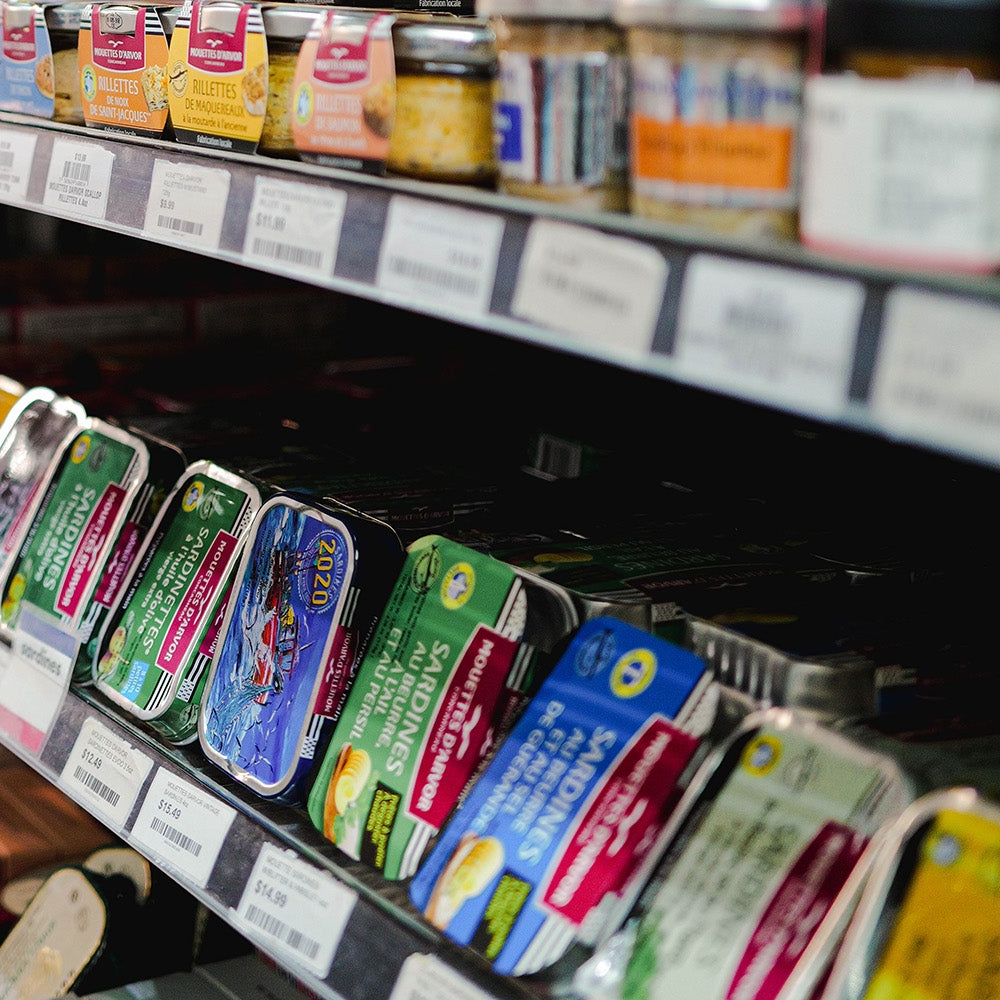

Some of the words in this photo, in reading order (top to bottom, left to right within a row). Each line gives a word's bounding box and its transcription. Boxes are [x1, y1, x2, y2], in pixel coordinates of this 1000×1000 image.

[446, 0, 462, 7] locale
[94, 47, 118, 58] MOUETTES
[119, 49, 142, 61] D'ARVOR
[99, 77, 139, 96] RILLETTES
[106, 95, 115, 105] DE
[115, 96, 129, 107] NOIX
[193, 79, 237, 99] RILLETTES
[90, 103, 98, 116] DE
[185, 98, 194, 110] DE
[195, 100, 246, 117] MAQUEREAUX
[43, 487, 98, 591] SARDINES
[83, 491, 118, 553] MOUETTES
[185, 533, 194, 543] à
[62, 553, 92, 608] D'ARVOR
[153, 550, 177, 582] vierge
[161, 544, 190, 589] l'huile
[194, 539, 227, 603] MOUETTES
[312, 539, 337, 606] 2020
[327, 546, 346, 600] SARDINES
[136, 588, 166, 635] d'olive
[140, 580, 157, 609] extra
[163, 601, 196, 663] D'ARVOR
[384, 626, 404, 652] ET
[20, 643, 62, 677] sardines
[371, 652, 393, 681] AU
[407, 641, 425, 670] AU
[323, 670, 341, 713] MOUETTES
[372, 676, 399, 719] L'AIL
[449, 638, 495, 736] MOUETTES
[347, 680, 382, 742] PERSIL
[373, 672, 415, 751] BEURRE,
[386, 639, 450, 777] SARDINES
[537, 698, 565, 731] DE
[541, 726, 566, 754] ET
[562, 728, 585, 760] AU
[81, 748, 103, 770] $12.49
[415, 729, 457, 813] D'ARVOR
[522, 750, 550, 784] AU
[158, 799, 182, 820] $15.49
[509, 758, 567, 834] BEURRE
[518, 726, 616, 867] SARDINES
[254, 879, 288, 908] $14.99
